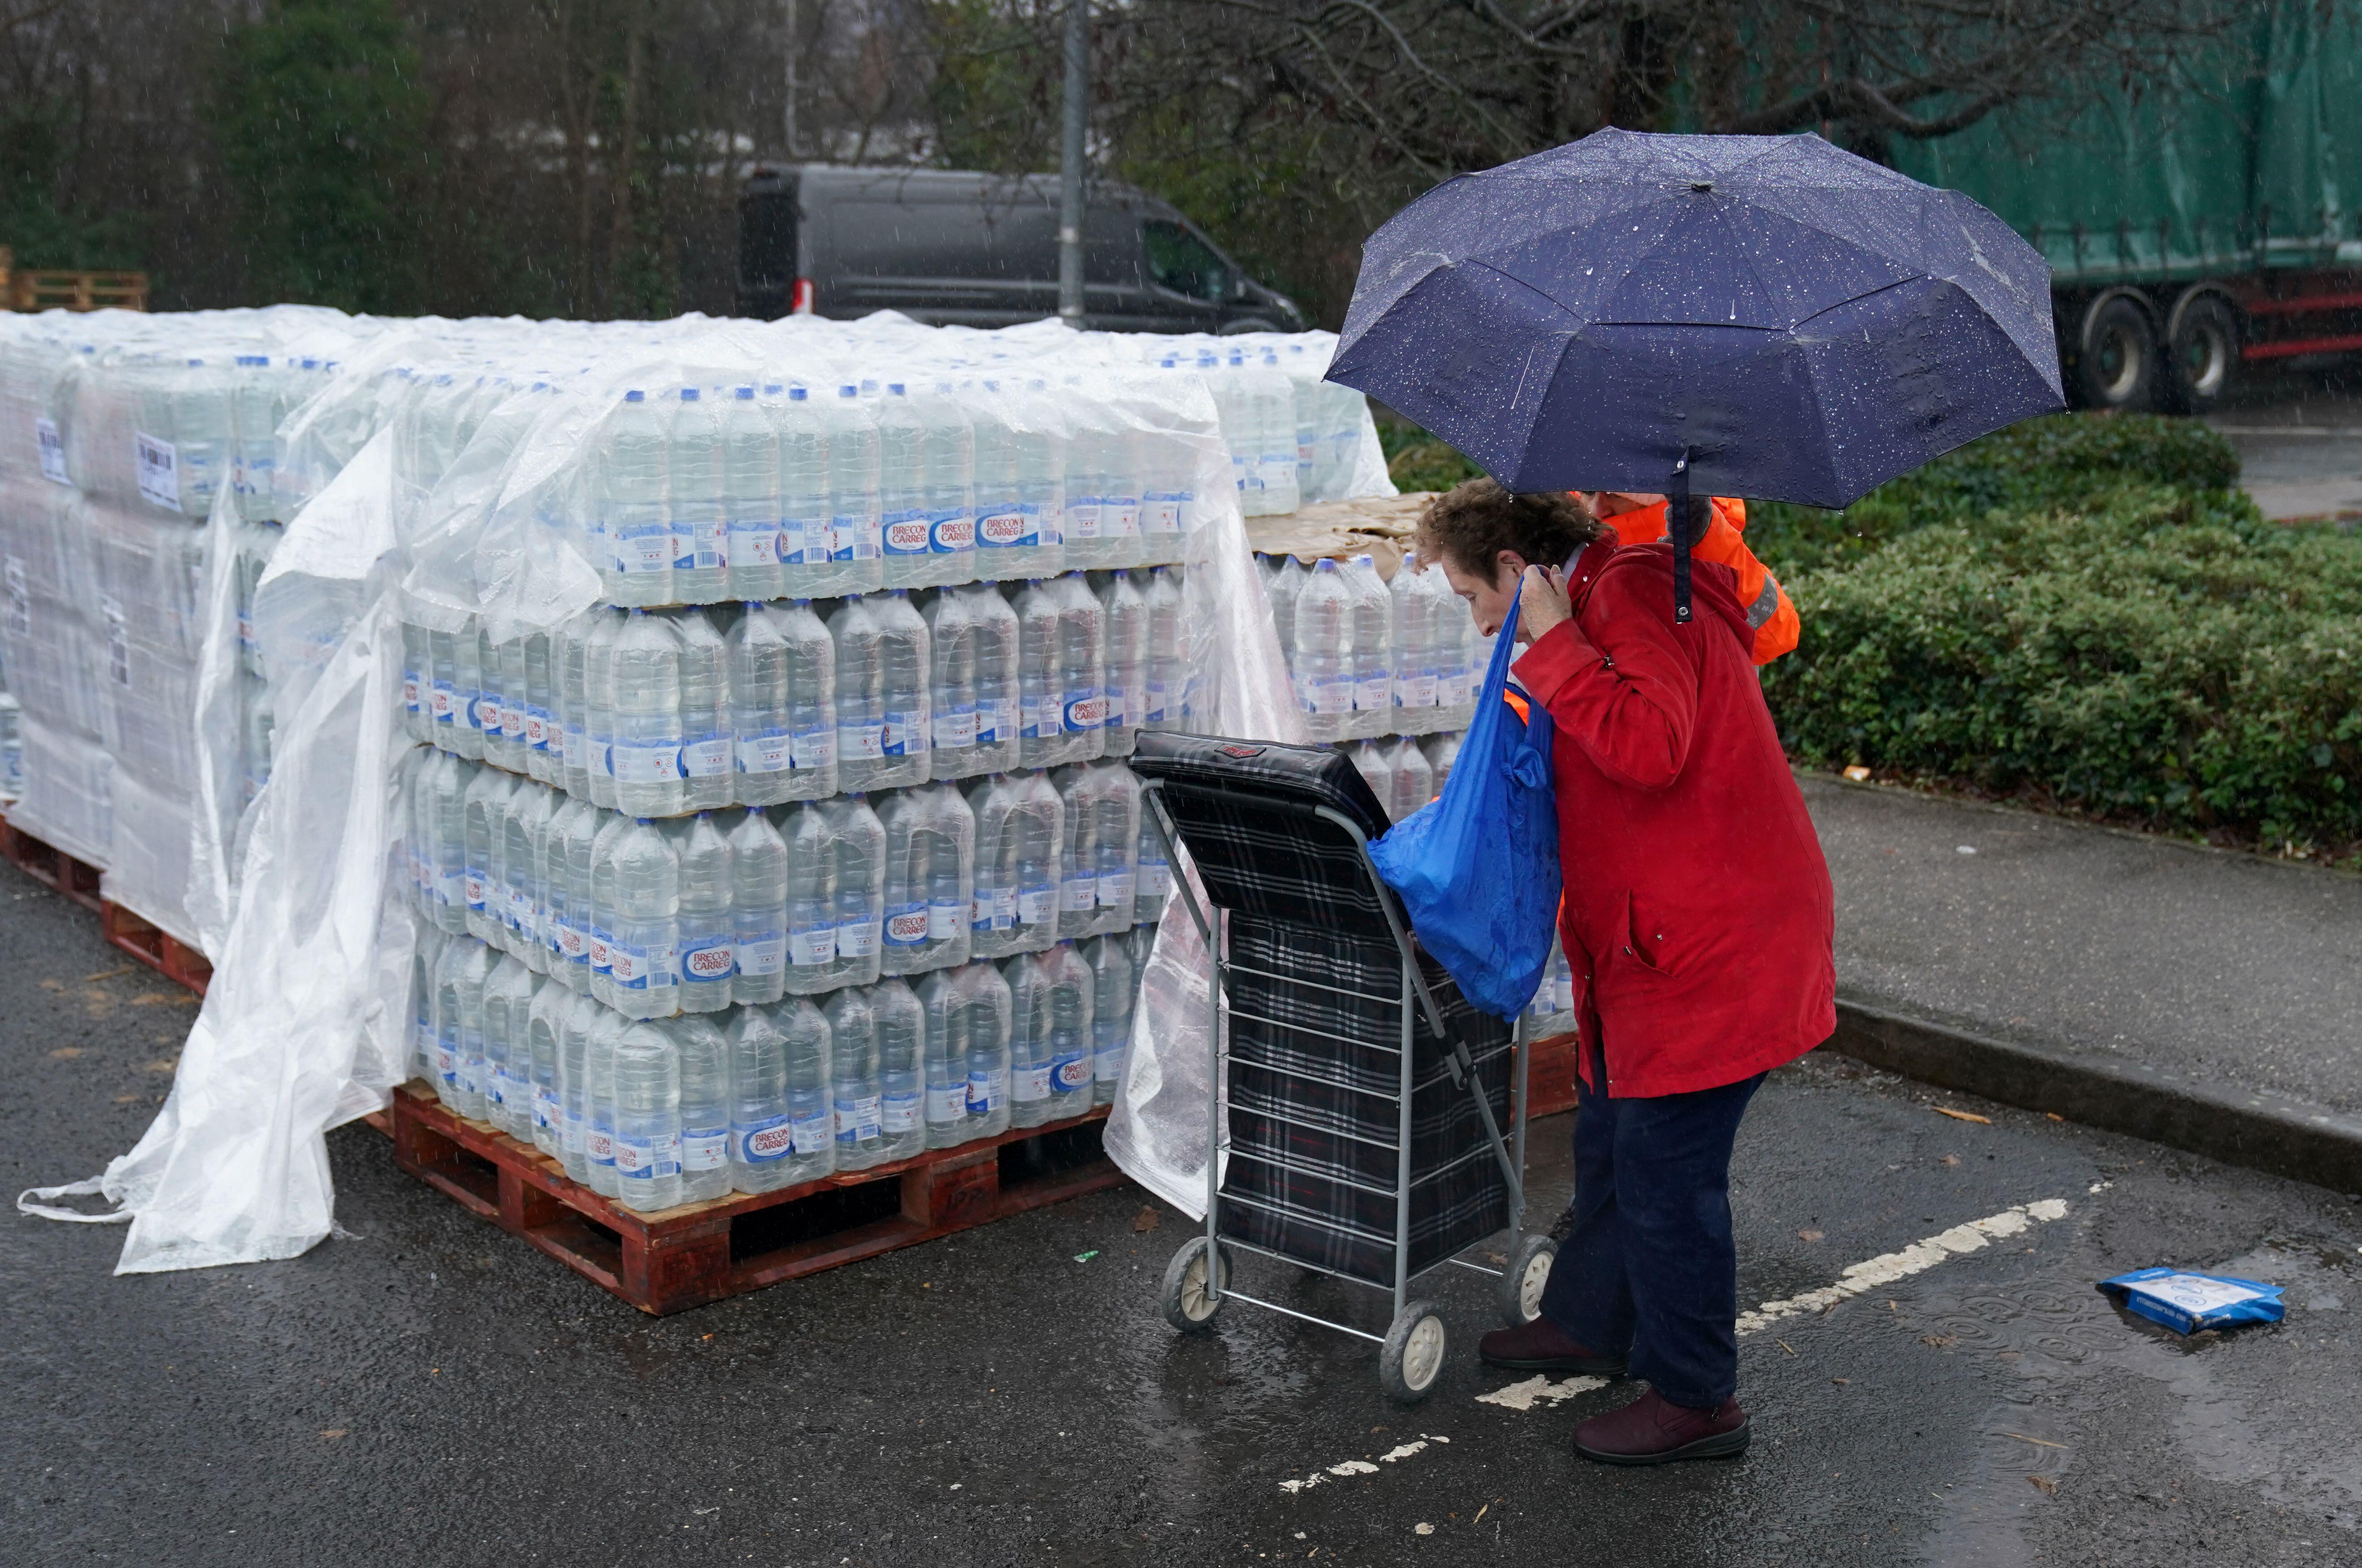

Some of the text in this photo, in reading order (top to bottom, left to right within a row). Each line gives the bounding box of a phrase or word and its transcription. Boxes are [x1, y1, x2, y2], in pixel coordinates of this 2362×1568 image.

[942, 522, 973, 533] BRECON
[987, 518, 1018, 528] BRECON
[893, 525, 926, 535] BRECON
[987, 527, 1018, 536] CARREG
[892, 534, 926, 544] CARREG
[941, 531, 973, 542] CARREG
[894, 916, 926, 927] BRECON
[893, 924, 926, 935] CARREG
[613, 954, 632, 968] ECON
[694, 950, 730, 962] BRECON
[693, 958, 730, 971] CARREG
[755, 1128, 788, 1143] BRECON
[755, 1136, 789, 1151] CARREG
